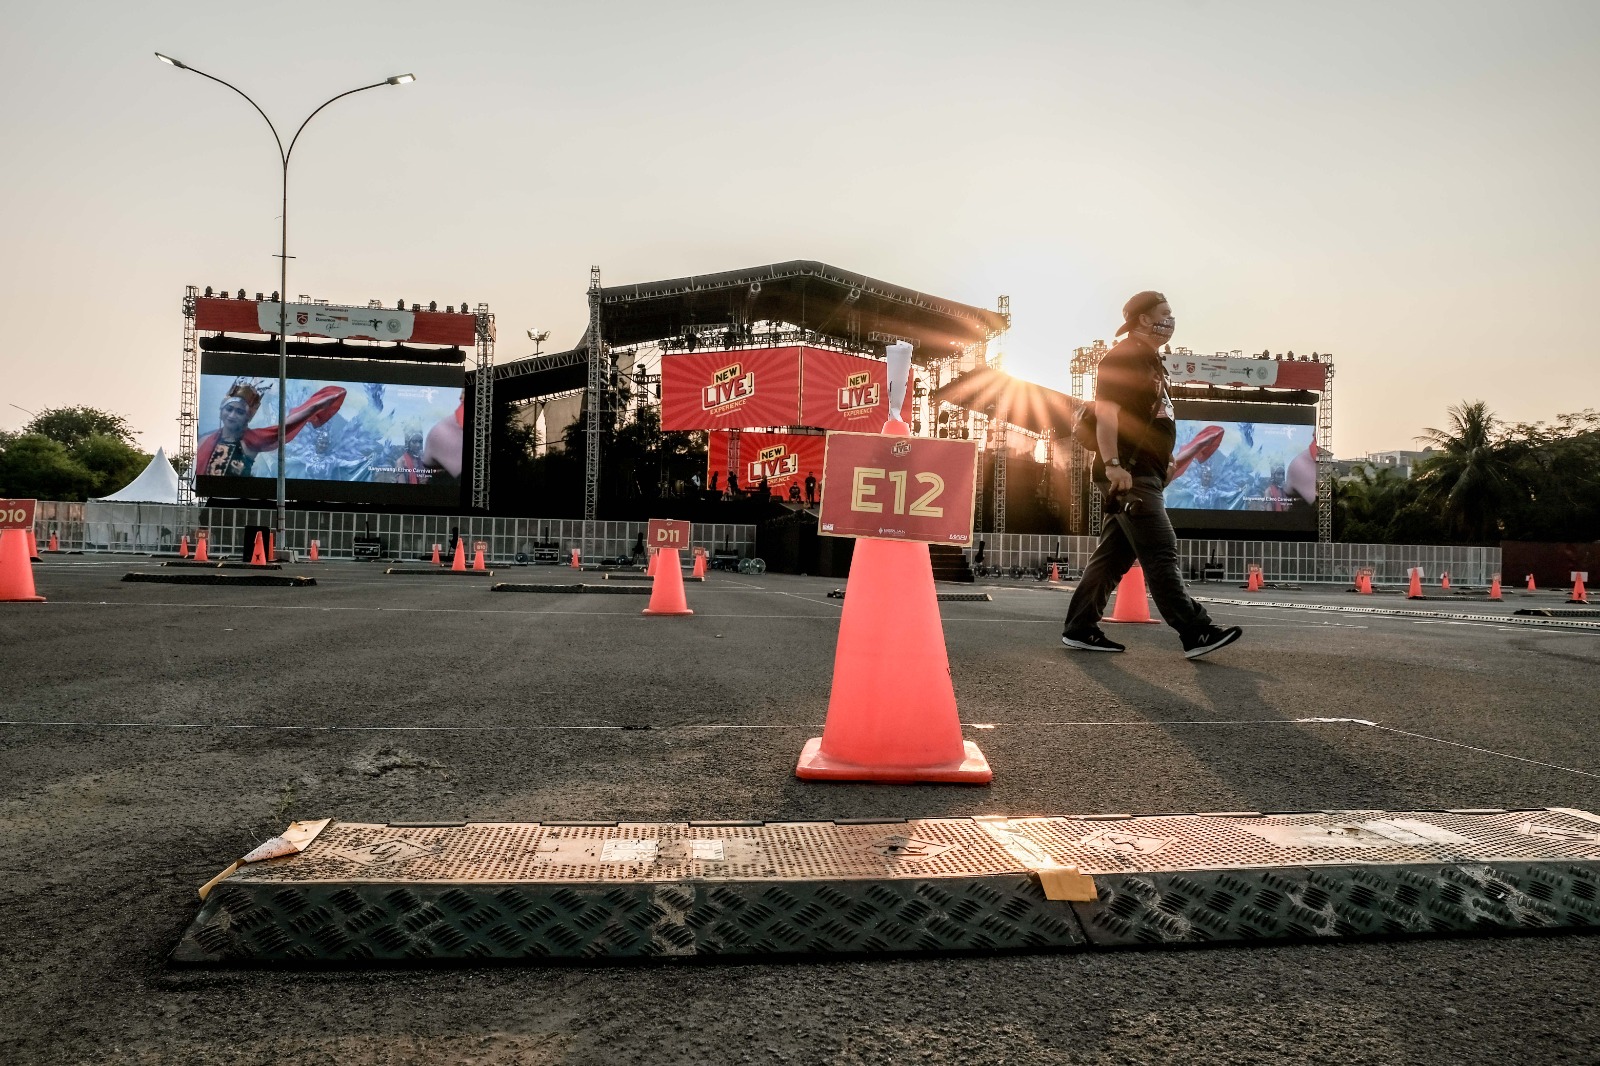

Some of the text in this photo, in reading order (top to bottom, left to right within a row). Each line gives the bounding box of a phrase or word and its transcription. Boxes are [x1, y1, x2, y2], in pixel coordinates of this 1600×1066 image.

[716, 366, 738, 383] NEW
[849, 376, 868, 387] NEW
[703, 373, 754, 409] LIVE!
[838, 383, 880, 410] LIVE!
[709, 399, 747, 415] EXPERIENCE
[843, 408, 873, 418] EXPERIENCE
[761, 447, 783, 460] NEW
[748, 454, 797, 481] LIVE!
[851, 466, 945, 518] E12
[657, 528, 680, 543] D11
